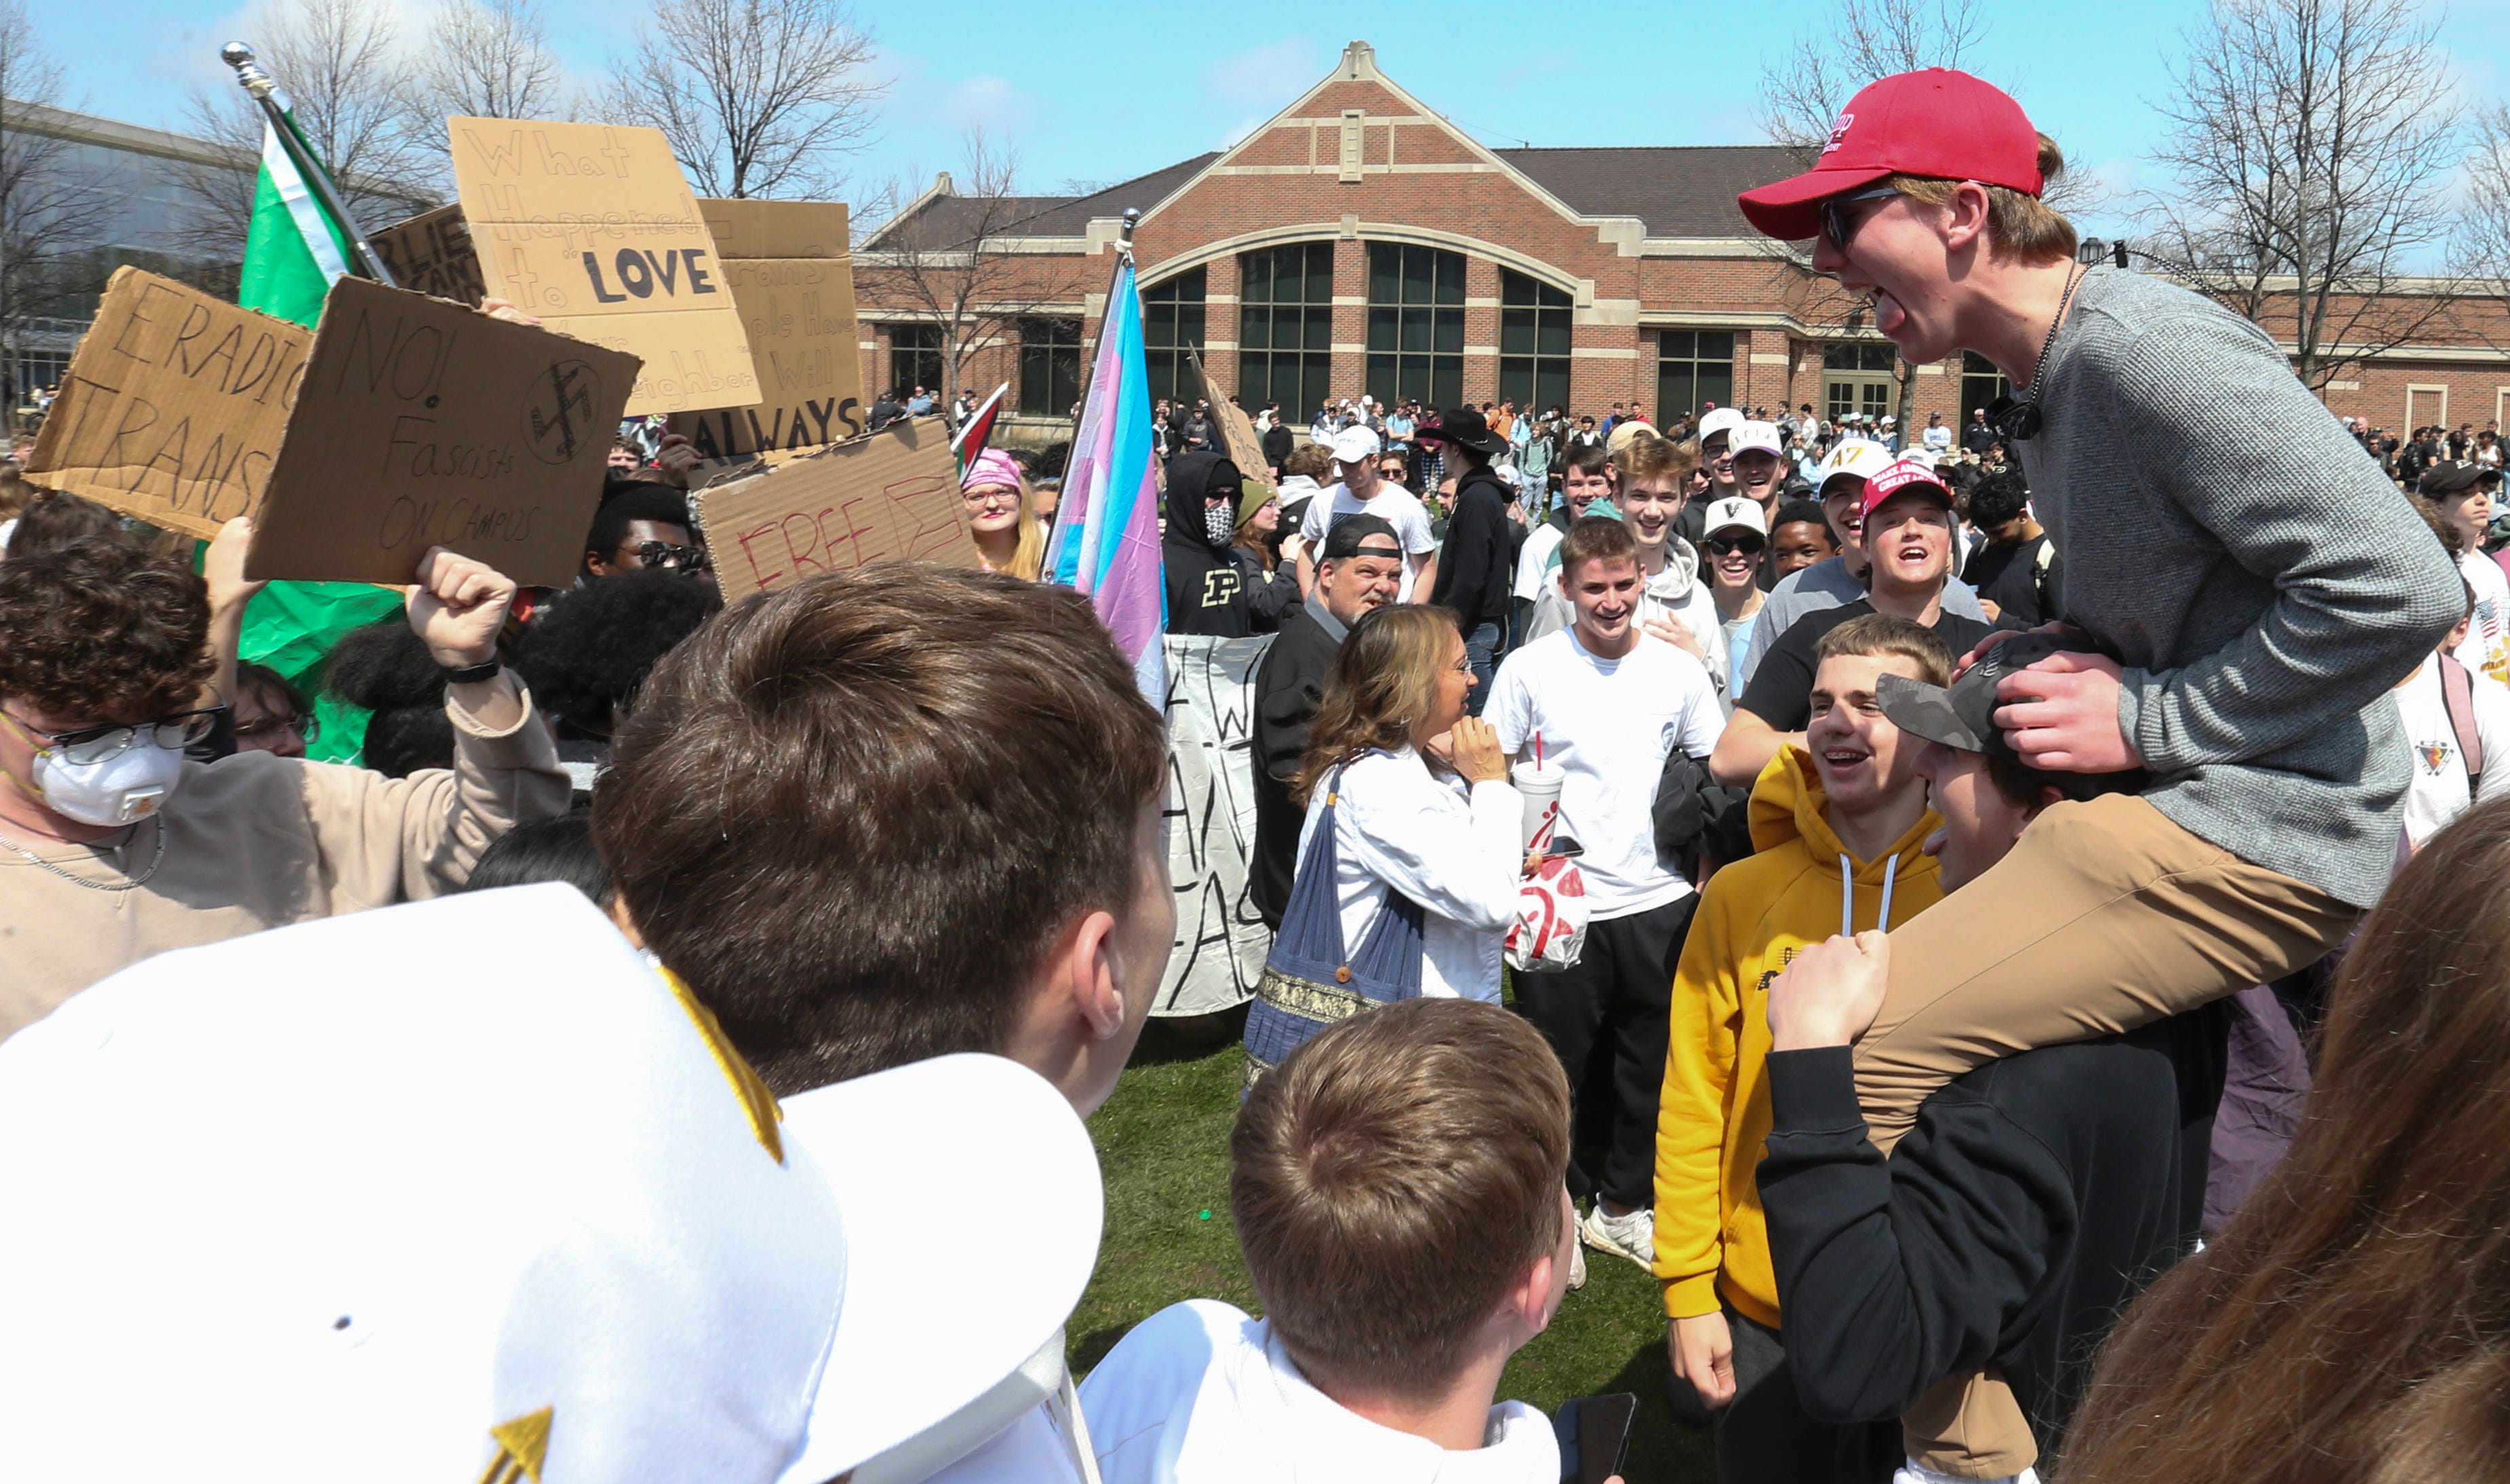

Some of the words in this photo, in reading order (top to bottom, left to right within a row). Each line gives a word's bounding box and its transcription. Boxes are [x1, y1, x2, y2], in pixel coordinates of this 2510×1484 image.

[462, 127, 629, 178] What
[479, 183, 699, 248] Happened
[336, 308, 458, 409] NO!
[769, 346, 833, 391] Will
[382, 415, 515, 479] Fascists
[691, 397, 861, 470] ALWAYS
[1830, 447, 1864, 469] 47
[1872, 465, 1900, 485] MAKE
[1878, 473, 1911, 493] GREAT
[378, 495, 439, 550] ON
[737, 497, 885, 592] FREE
[1201, 569, 1241, 608] P
